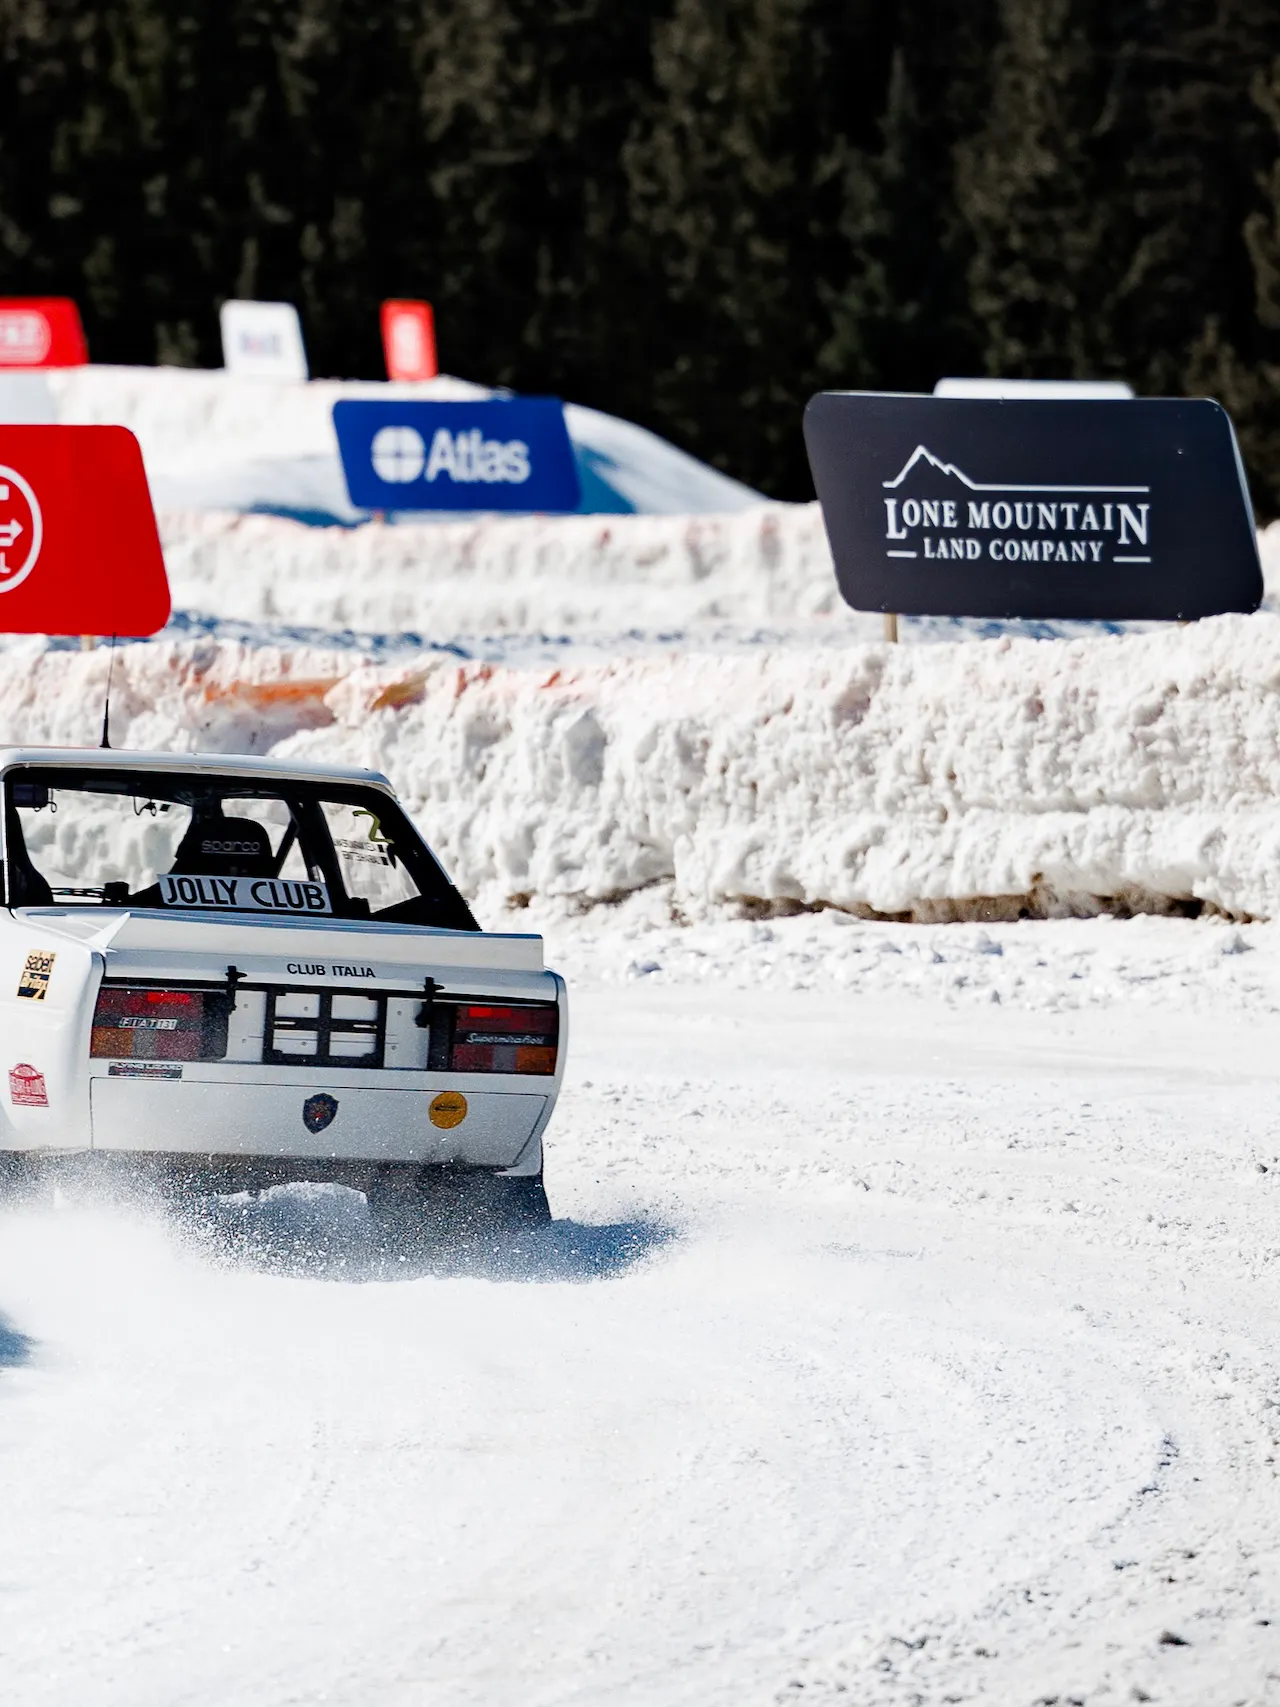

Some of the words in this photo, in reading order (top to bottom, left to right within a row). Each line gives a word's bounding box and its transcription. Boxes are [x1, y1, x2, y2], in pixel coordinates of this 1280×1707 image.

[424, 427, 531, 484] Atlas
[884, 498, 958, 539] LONE
[967, 501, 1151, 545] MOUNTAIN
[923, 538, 981, 560] LAND
[988, 540, 1103, 562] COMPANY
[201, 839, 261, 852] sparco
[167, 877, 238, 906] JOLLY
[250, 881, 326, 910] CLUB
[25, 951, 56, 973] sabelt
[287, 963, 326, 976] CLUB
[332, 965, 376, 978] ITALIA
[121, 1017, 157, 1029] FIAT
[157, 1019, 177, 1030] 131
